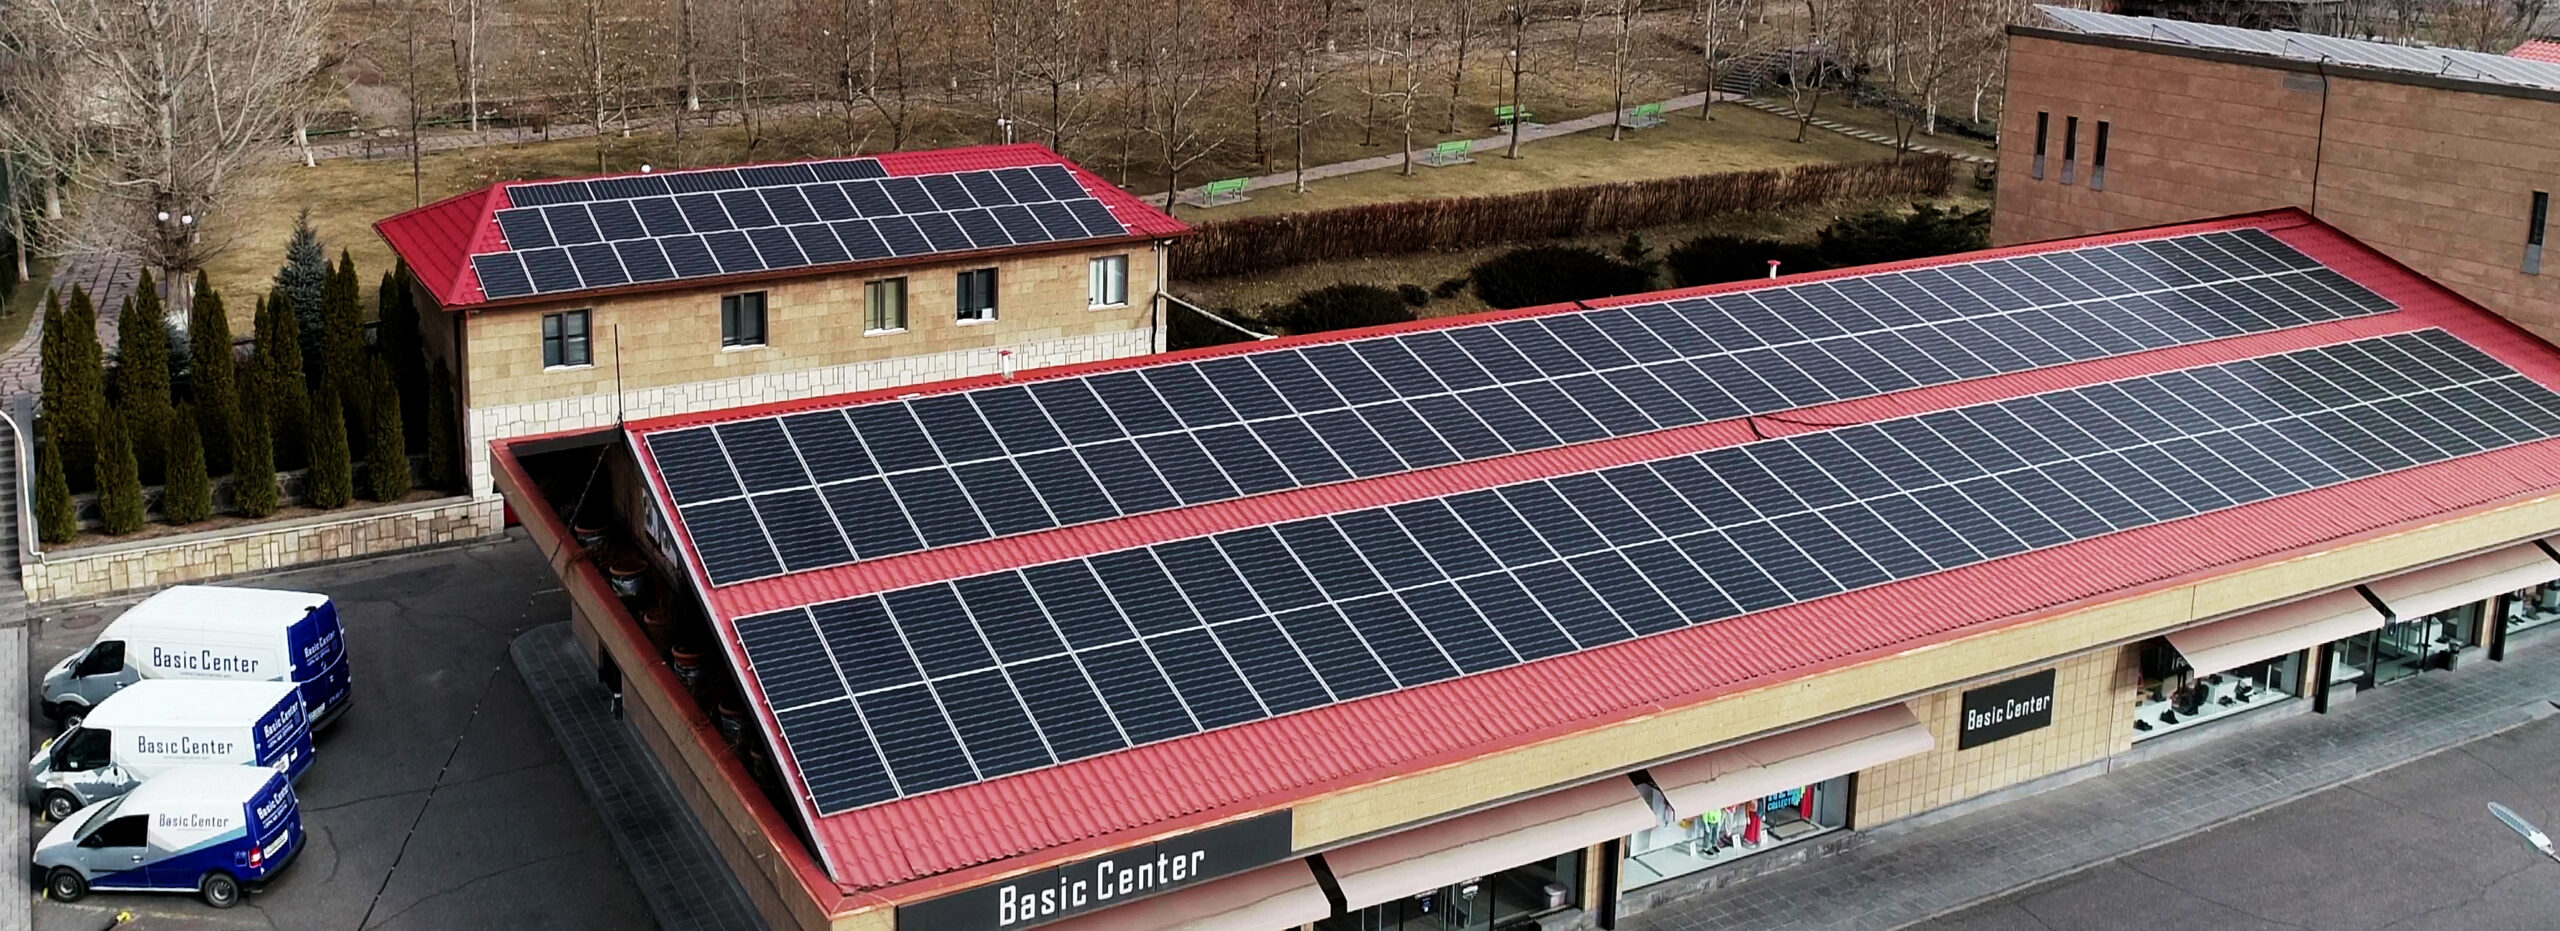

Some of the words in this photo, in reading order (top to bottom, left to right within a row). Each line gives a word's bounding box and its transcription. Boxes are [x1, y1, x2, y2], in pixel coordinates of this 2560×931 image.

[153, 646, 197, 670] Basic
[201, 648, 258, 673] Center
[1967, 705, 2003, 731] Basic
[2005, 695, 2050, 720] Center
[138, 735, 178, 754] Basic
[181, 736, 233, 755] Center
[159, 812, 188, 827] Basic
[190, 813, 229, 828] Center
[999, 876, 1087, 927] Basic
[1096, 849, 1205, 901] Center
